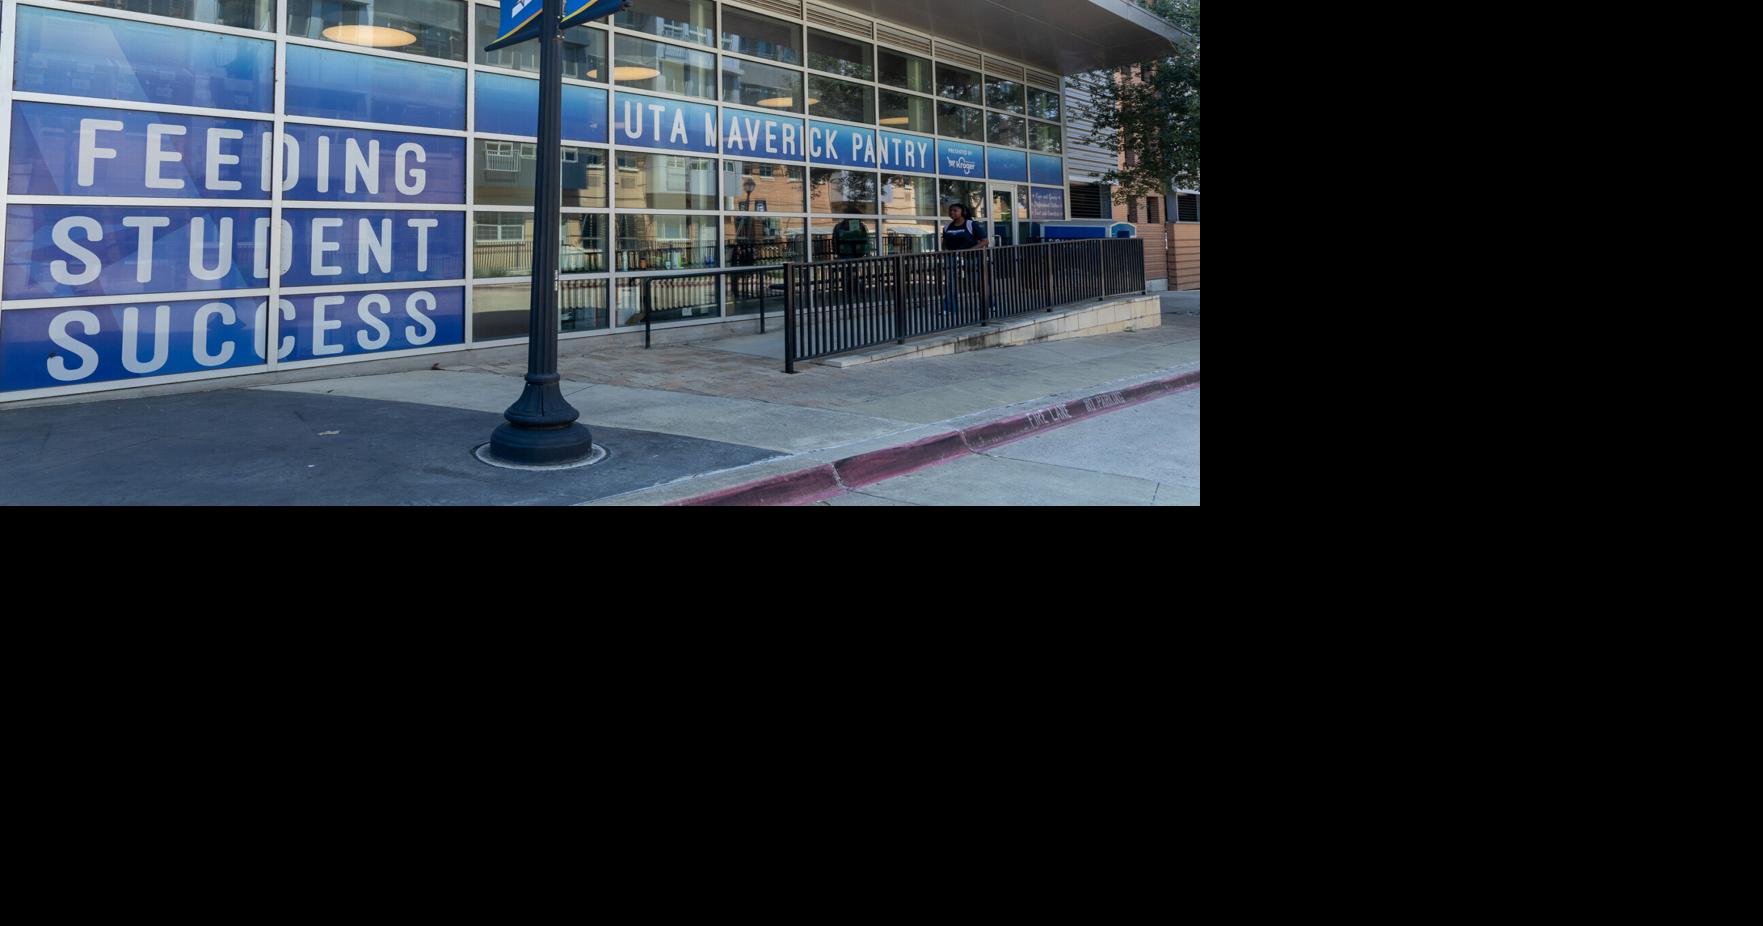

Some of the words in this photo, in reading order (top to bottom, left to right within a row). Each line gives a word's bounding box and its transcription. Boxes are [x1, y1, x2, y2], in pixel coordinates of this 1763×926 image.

[77, 118, 427, 195] FEEDING
[624, 100, 688, 144] UTA
[705, 112, 838, 160] MAVERICK
[852, 132, 928, 169] PANTRY
[49, 216, 439, 286] STUDENT
[46, 290, 437, 382] SUCCESS
[1026, 410, 1049, 429] FIRE
[1047, 404, 1072, 421] LANE
